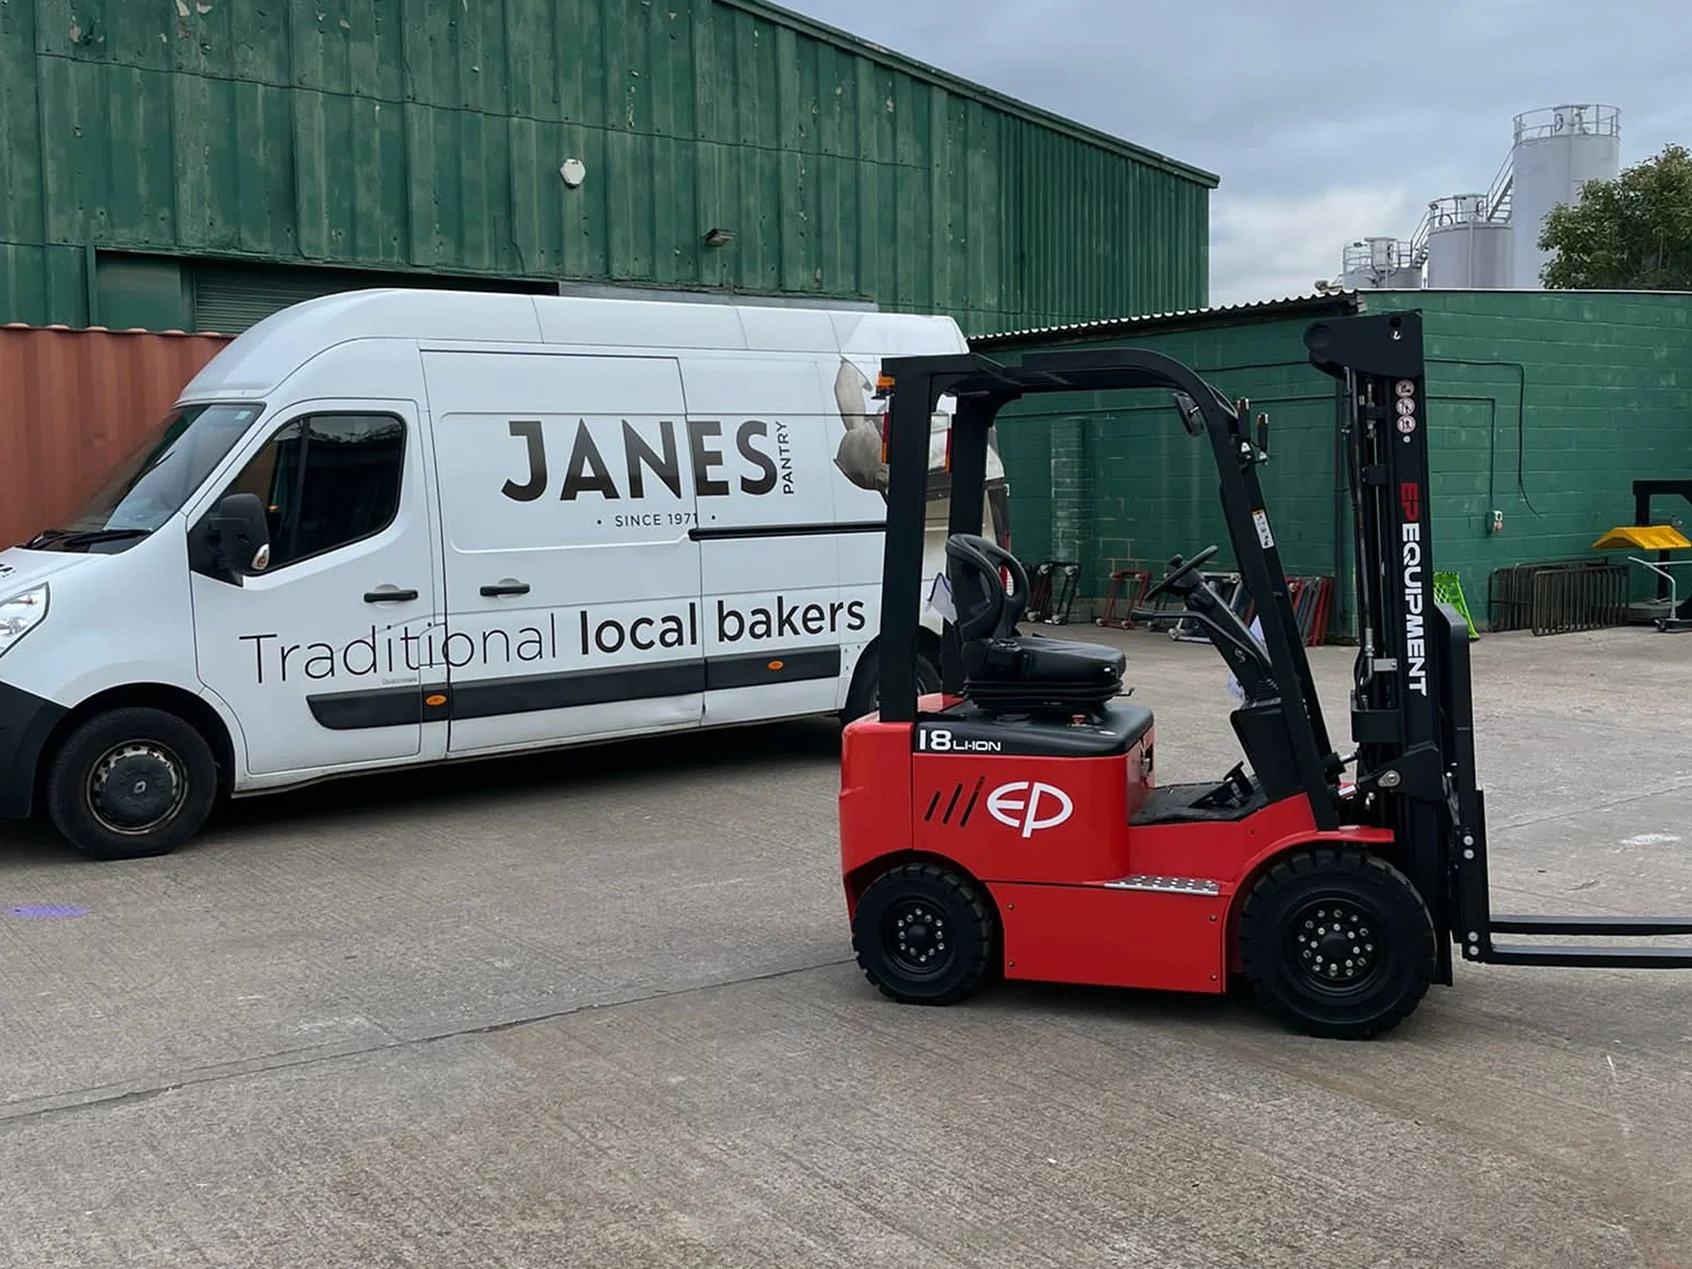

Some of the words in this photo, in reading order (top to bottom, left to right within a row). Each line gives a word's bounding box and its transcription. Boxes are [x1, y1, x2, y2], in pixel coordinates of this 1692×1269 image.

[501, 418, 778, 501] JANES
[775, 421, 794, 494] PANTRY
[615, 514, 661, 527] SINCE
[668, 513, 697, 525] 1971
[1401, 482, 1419, 521] EP
[239, 613, 556, 683] Traditional
[580, 602, 697, 655] local
[717, 596, 866, 642] bakers
[1402, 522, 1427, 696] EQUIPMENT
[919, 729, 952, 750] 18
[987, 781, 1073, 837] EP
